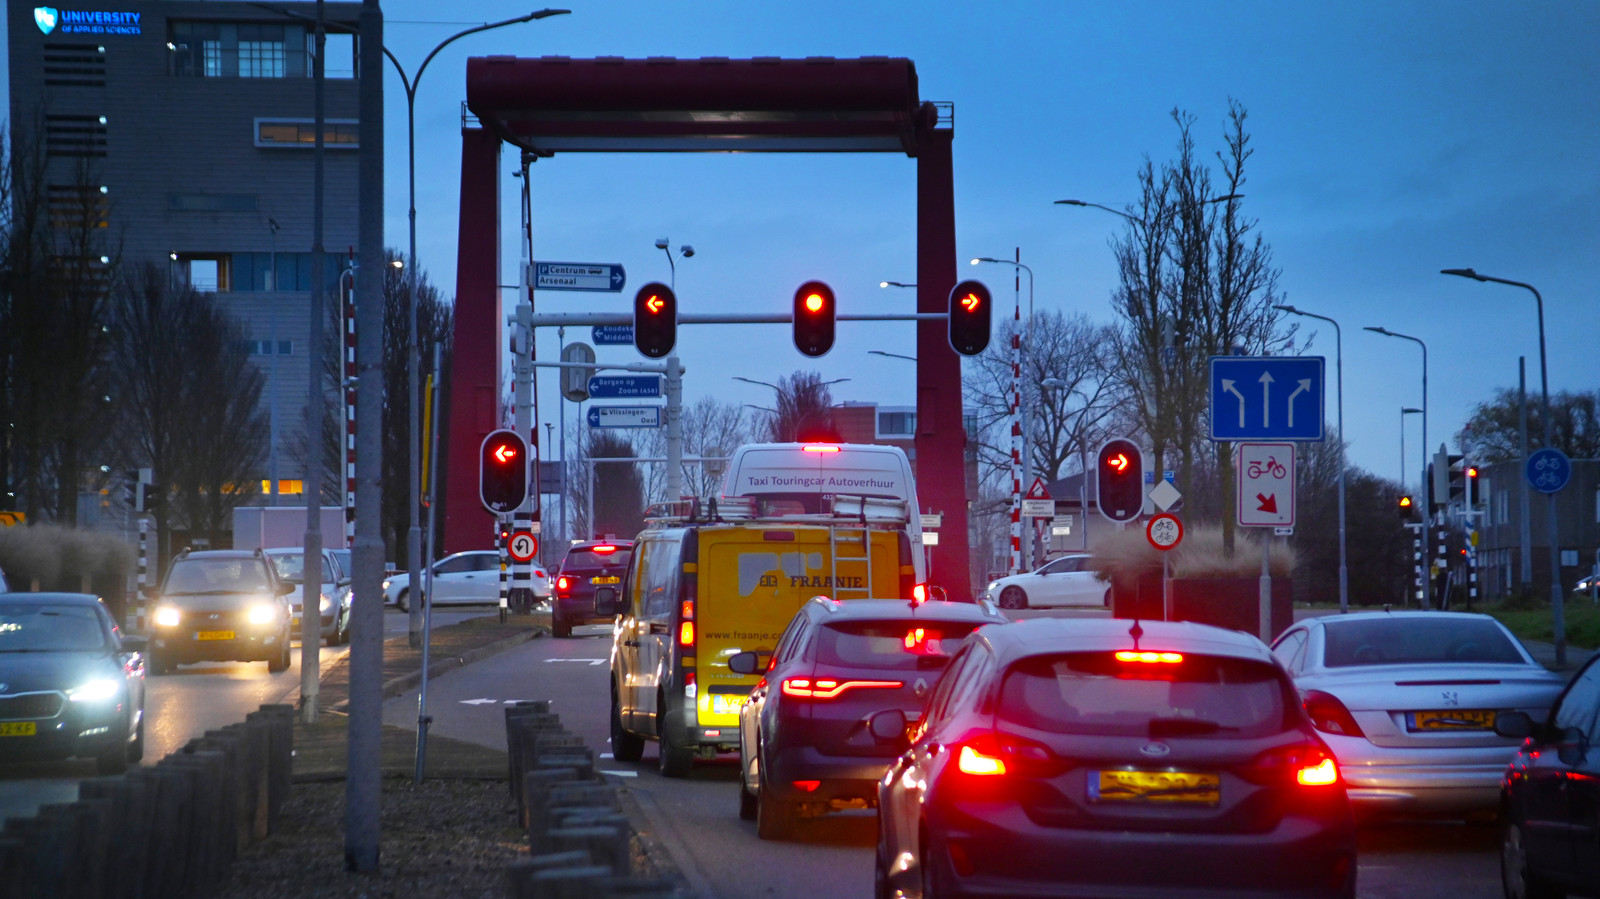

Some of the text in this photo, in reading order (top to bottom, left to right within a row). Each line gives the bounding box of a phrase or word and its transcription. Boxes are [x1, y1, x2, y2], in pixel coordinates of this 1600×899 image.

[61, 10, 141, 24] UNIVERSITY
[61, 25, 141, 34] OF APPLIED SCIENCES
[550, 266, 586, 275] Centrum
[540, 277, 577, 285] Arsenaal
[609, 408, 647, 416] Vlissingen-
[748, 476, 895, 489] Taxi Touringcar Autoverhuur
